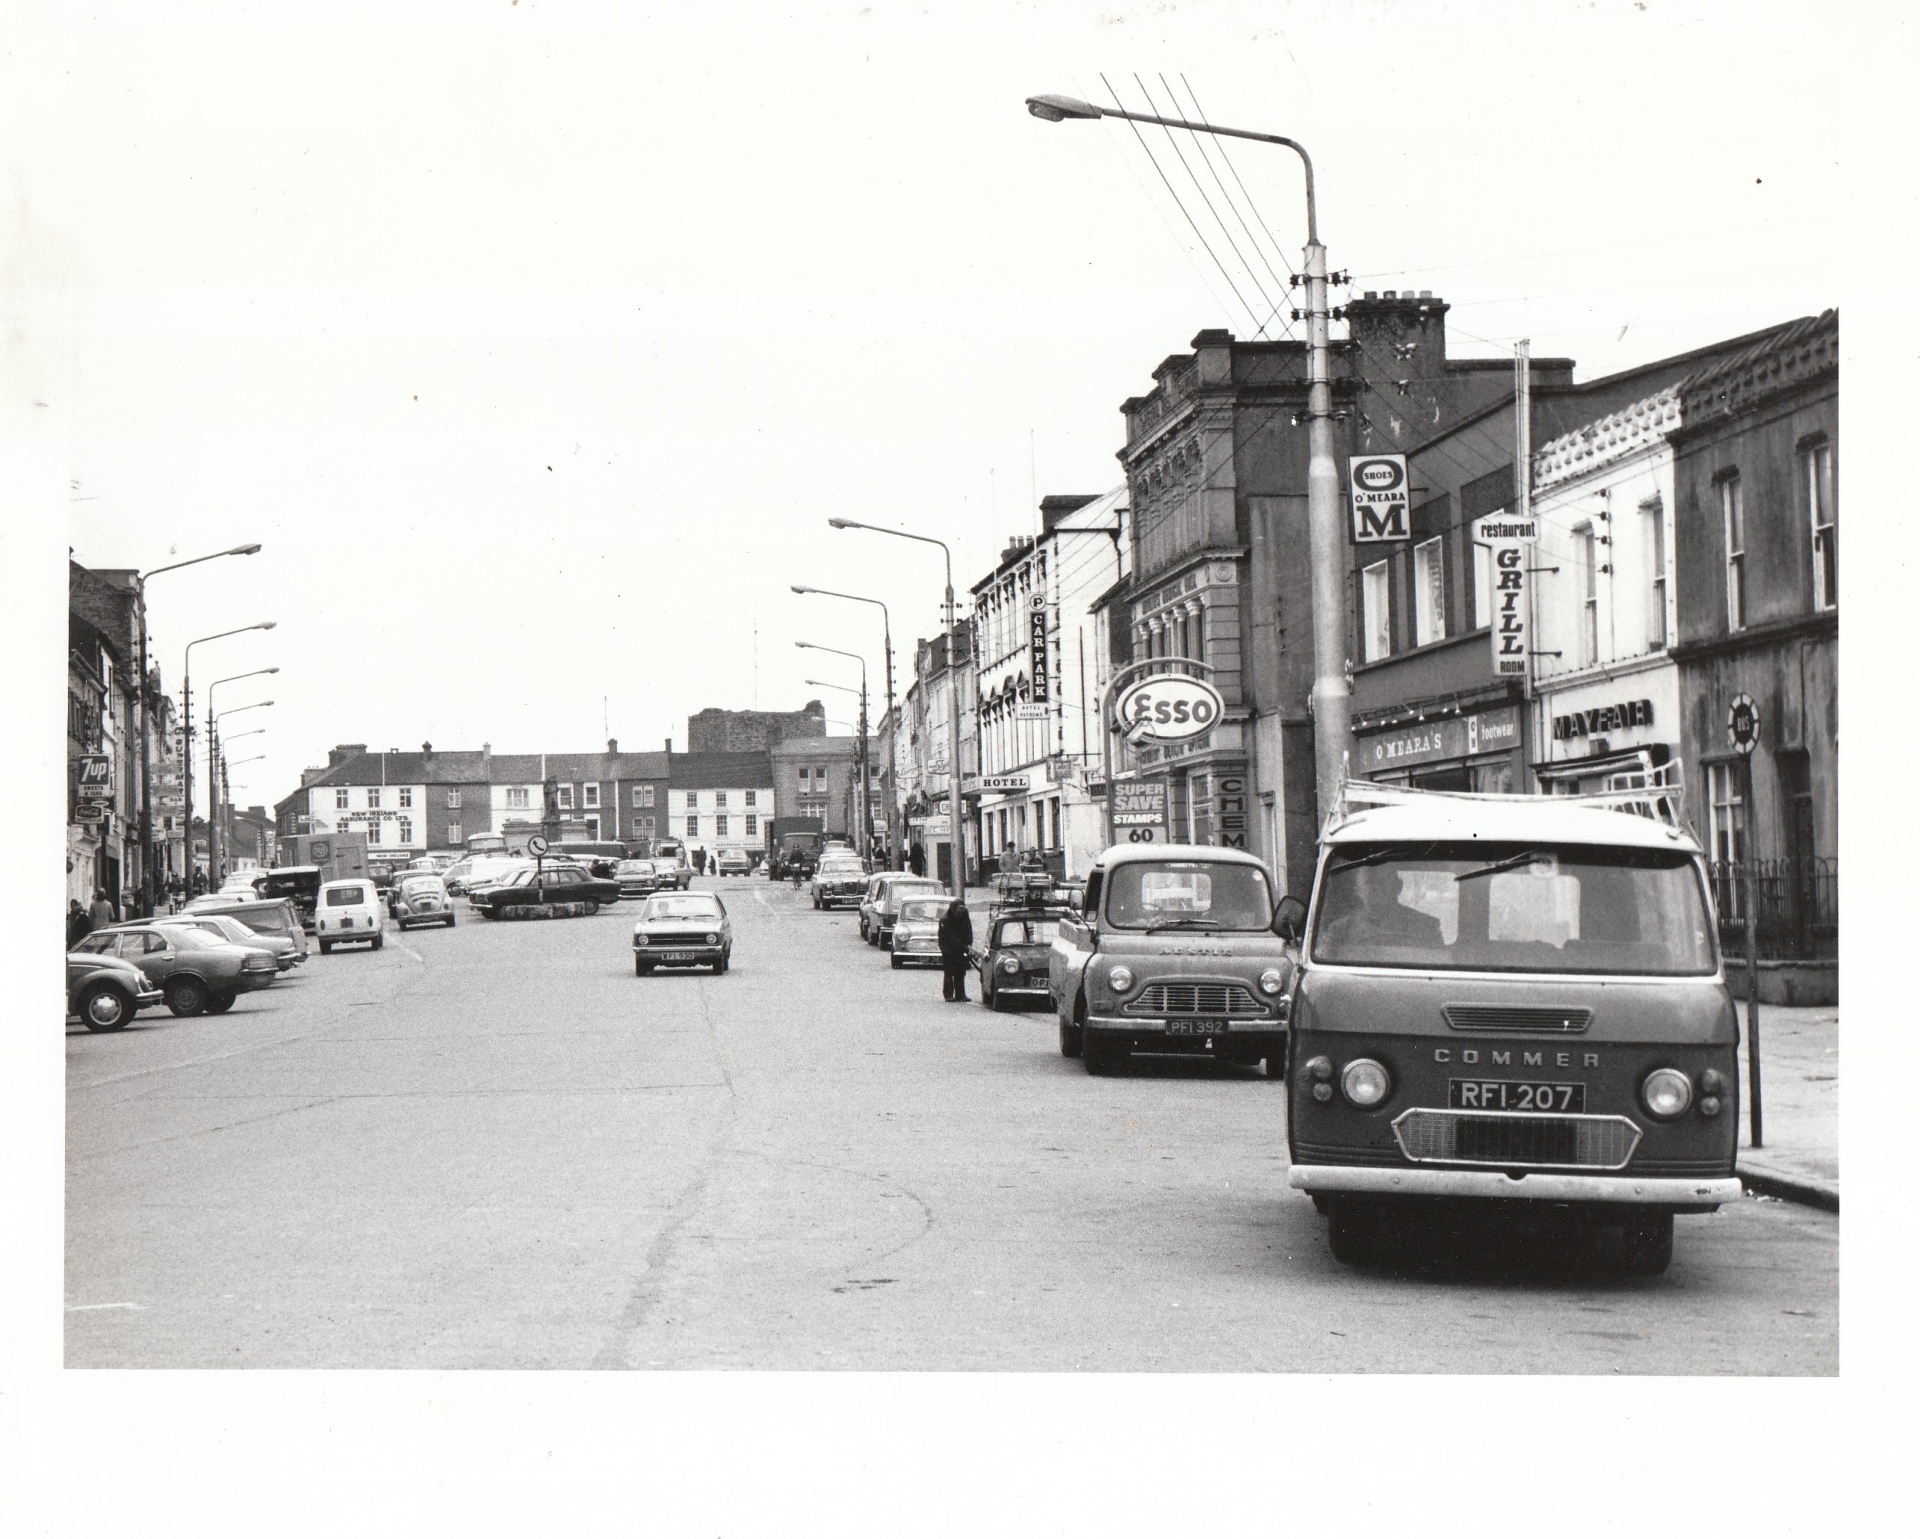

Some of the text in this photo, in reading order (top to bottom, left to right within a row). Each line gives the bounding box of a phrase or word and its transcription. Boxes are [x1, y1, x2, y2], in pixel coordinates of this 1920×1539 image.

[1364, 471, 1393, 480] SHOES
[1355, 492, 1406, 503] O'MEARA
[1356, 503, 1407, 537] M
[1481, 521, 1536, 538] restaurant
[1033, 597, 1043, 607] P
[1496, 549, 1524, 655] GRILL
[1033, 615, 1046, 696] CAR PARK
[1500, 660, 1525, 673] ROOM
[1481, 723, 1514, 741] footwear
[1376, 731, 1442, 760] O'MEARA'S
[983, 778, 1027, 787] HOTEL
[1115, 783, 1164, 795] SUPER
[1114, 795, 1163, 811] SAVE
[1113, 813, 1163, 824] STAMPS
[1128, 828, 1154, 843] 60
[1434, 1049, 1599, 1067] COMMER
